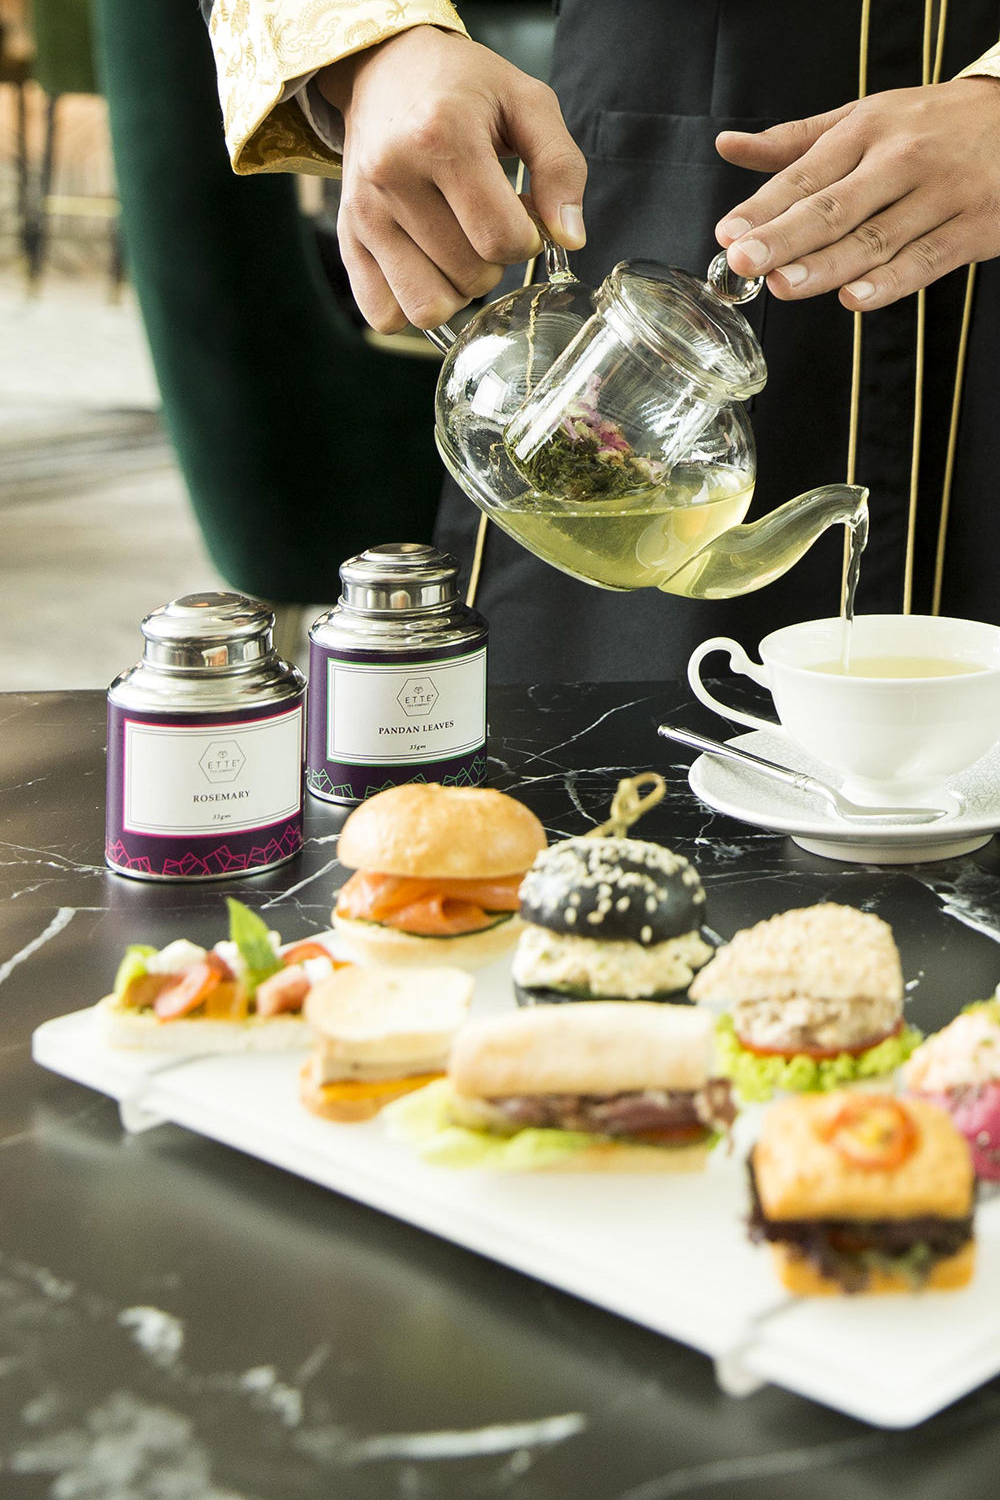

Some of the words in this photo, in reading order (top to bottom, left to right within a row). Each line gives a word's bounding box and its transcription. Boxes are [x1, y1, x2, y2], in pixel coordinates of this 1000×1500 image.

[378, 725, 420, 735] PANDAN
[423, 720, 455, 732] LEAVES
[193, 790, 250, 803] ROSEMARY
